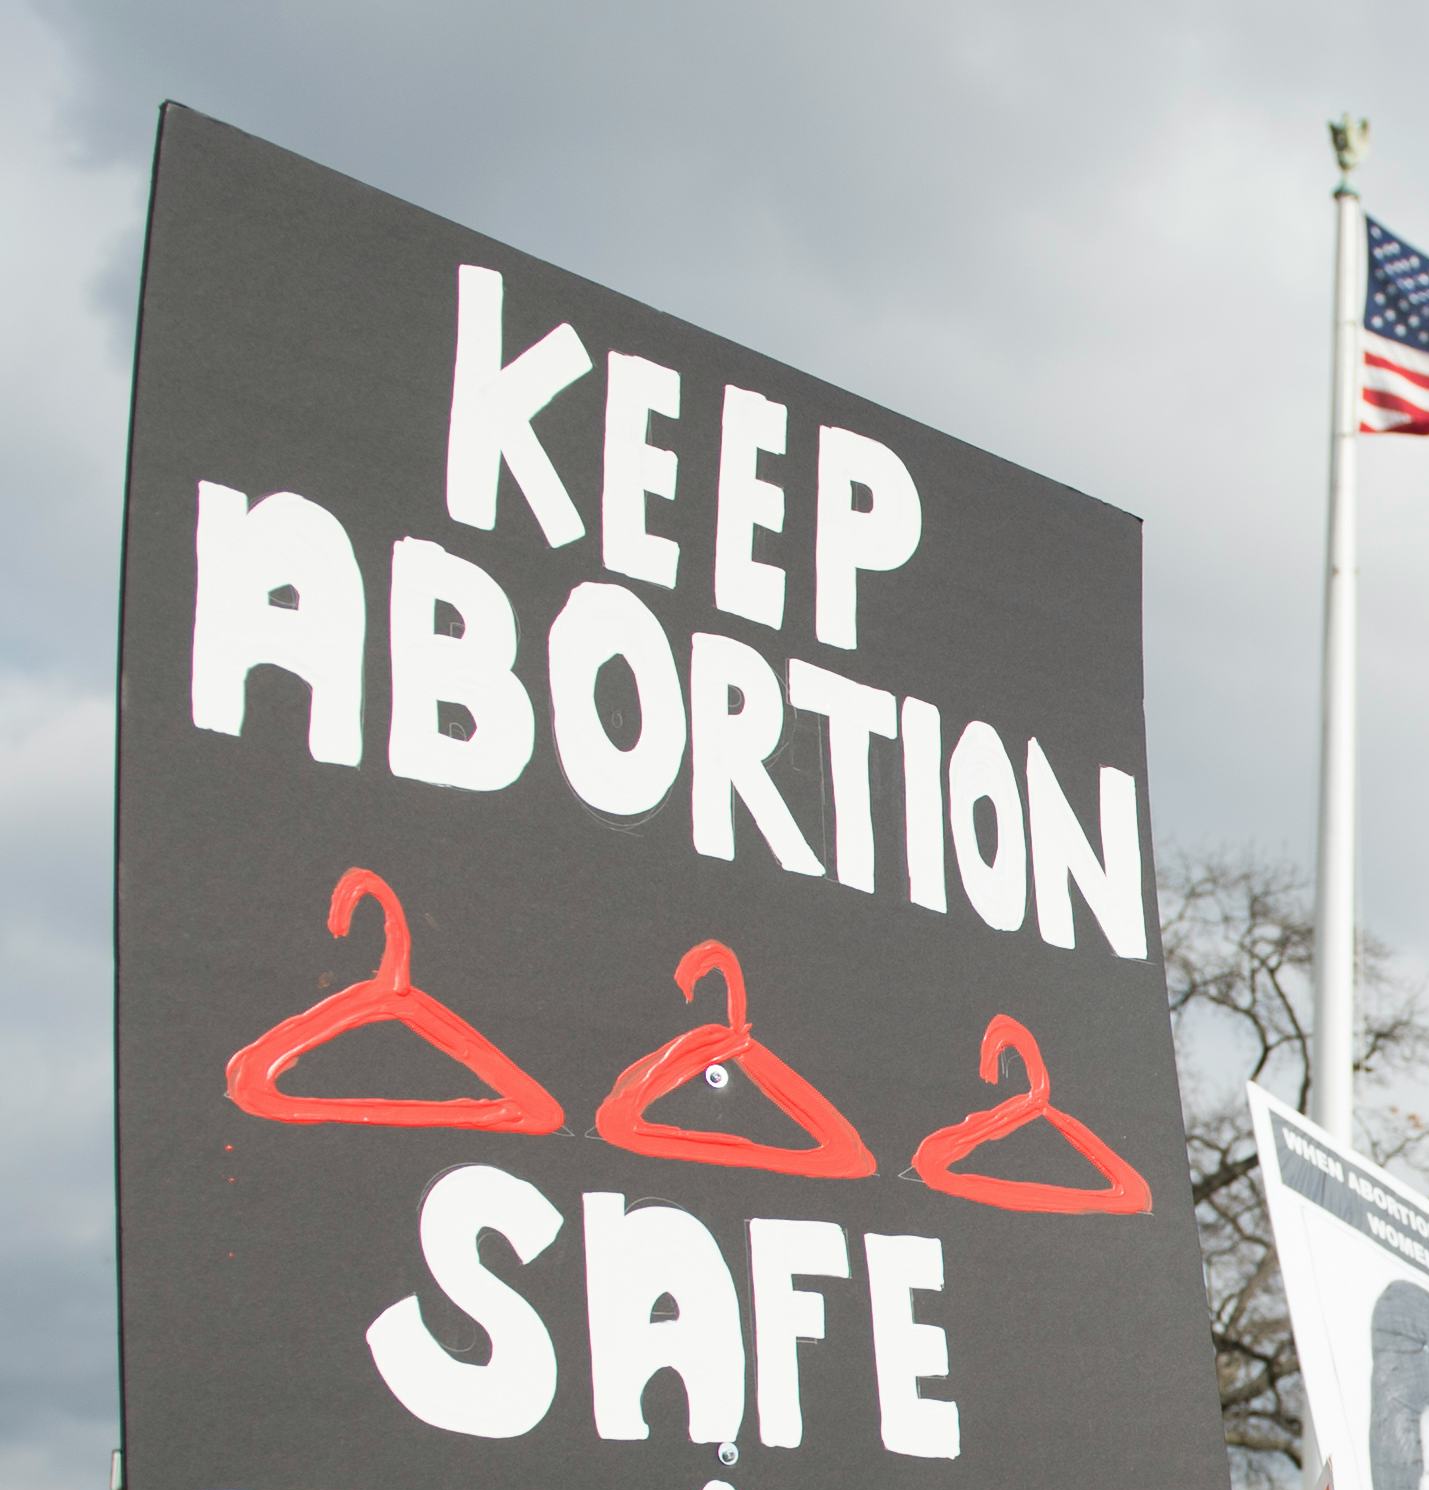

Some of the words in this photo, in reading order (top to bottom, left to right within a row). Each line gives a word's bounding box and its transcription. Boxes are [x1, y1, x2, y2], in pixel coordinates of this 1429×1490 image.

[447, 264, 922, 649] KEEP
[193, 480, 1147, 959] ABORTION
[366, 1165, 960, 1459] SAFE
[1282, 1127, 1344, 1183] WHEN
